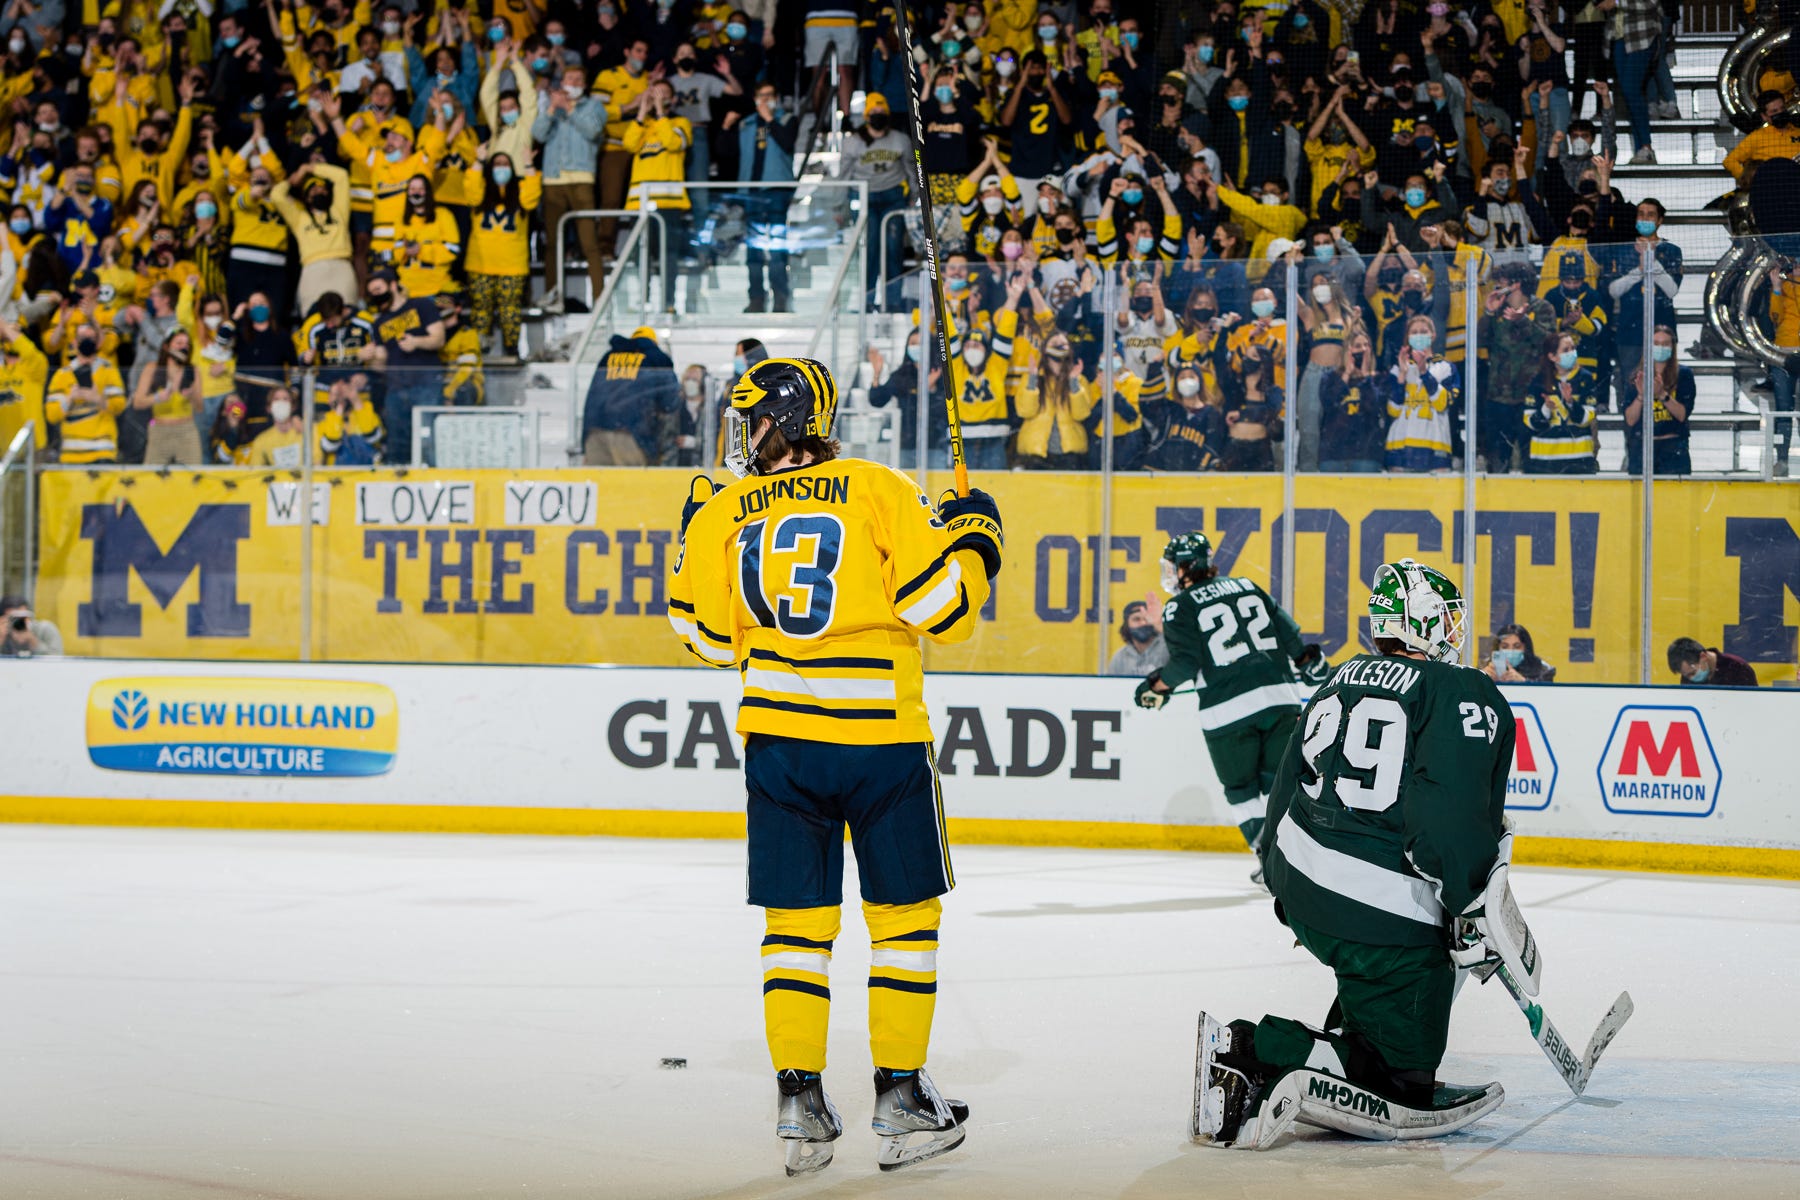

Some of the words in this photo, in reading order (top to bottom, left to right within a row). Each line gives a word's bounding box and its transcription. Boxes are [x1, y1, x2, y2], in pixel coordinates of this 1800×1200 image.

[1029, 103, 1050, 134] 2
[64, 218, 99, 248] M
[1494, 222, 1525, 250] M
[925, 237, 938, 281] BAUER
[963, 378, 996, 404] M
[806, 423, 818, 437] 13
[361, 485, 470, 525] LOVE
[509, 485, 590, 525] YOU
[733, 475, 850, 523] JOHNSON
[77, 503, 251, 638] M
[363, 529, 535, 615] THE
[1034, 535, 1142, 624] OF
[735, 511, 846, 640] 13
[1189, 579, 1244, 605] CESANA
[1369, 592, 1395, 611] ate
[1197, 594, 1279, 667] 22
[159, 701, 227, 727] NEW
[235, 702, 376, 729] HOLLAND
[1458, 701, 1500, 745] 29
[156, 745, 326, 772] AGRICULTURE
[607, 698, 1122, 781] GAADE
[1301, 693, 1408, 813] 29
[1617, 720, 1702, 778] M
[1612, 781, 1706, 801] MARATHON
[1544, 1026, 1582, 1080] BAUER
[1308, 1076, 1391, 1121] VAUGHN
